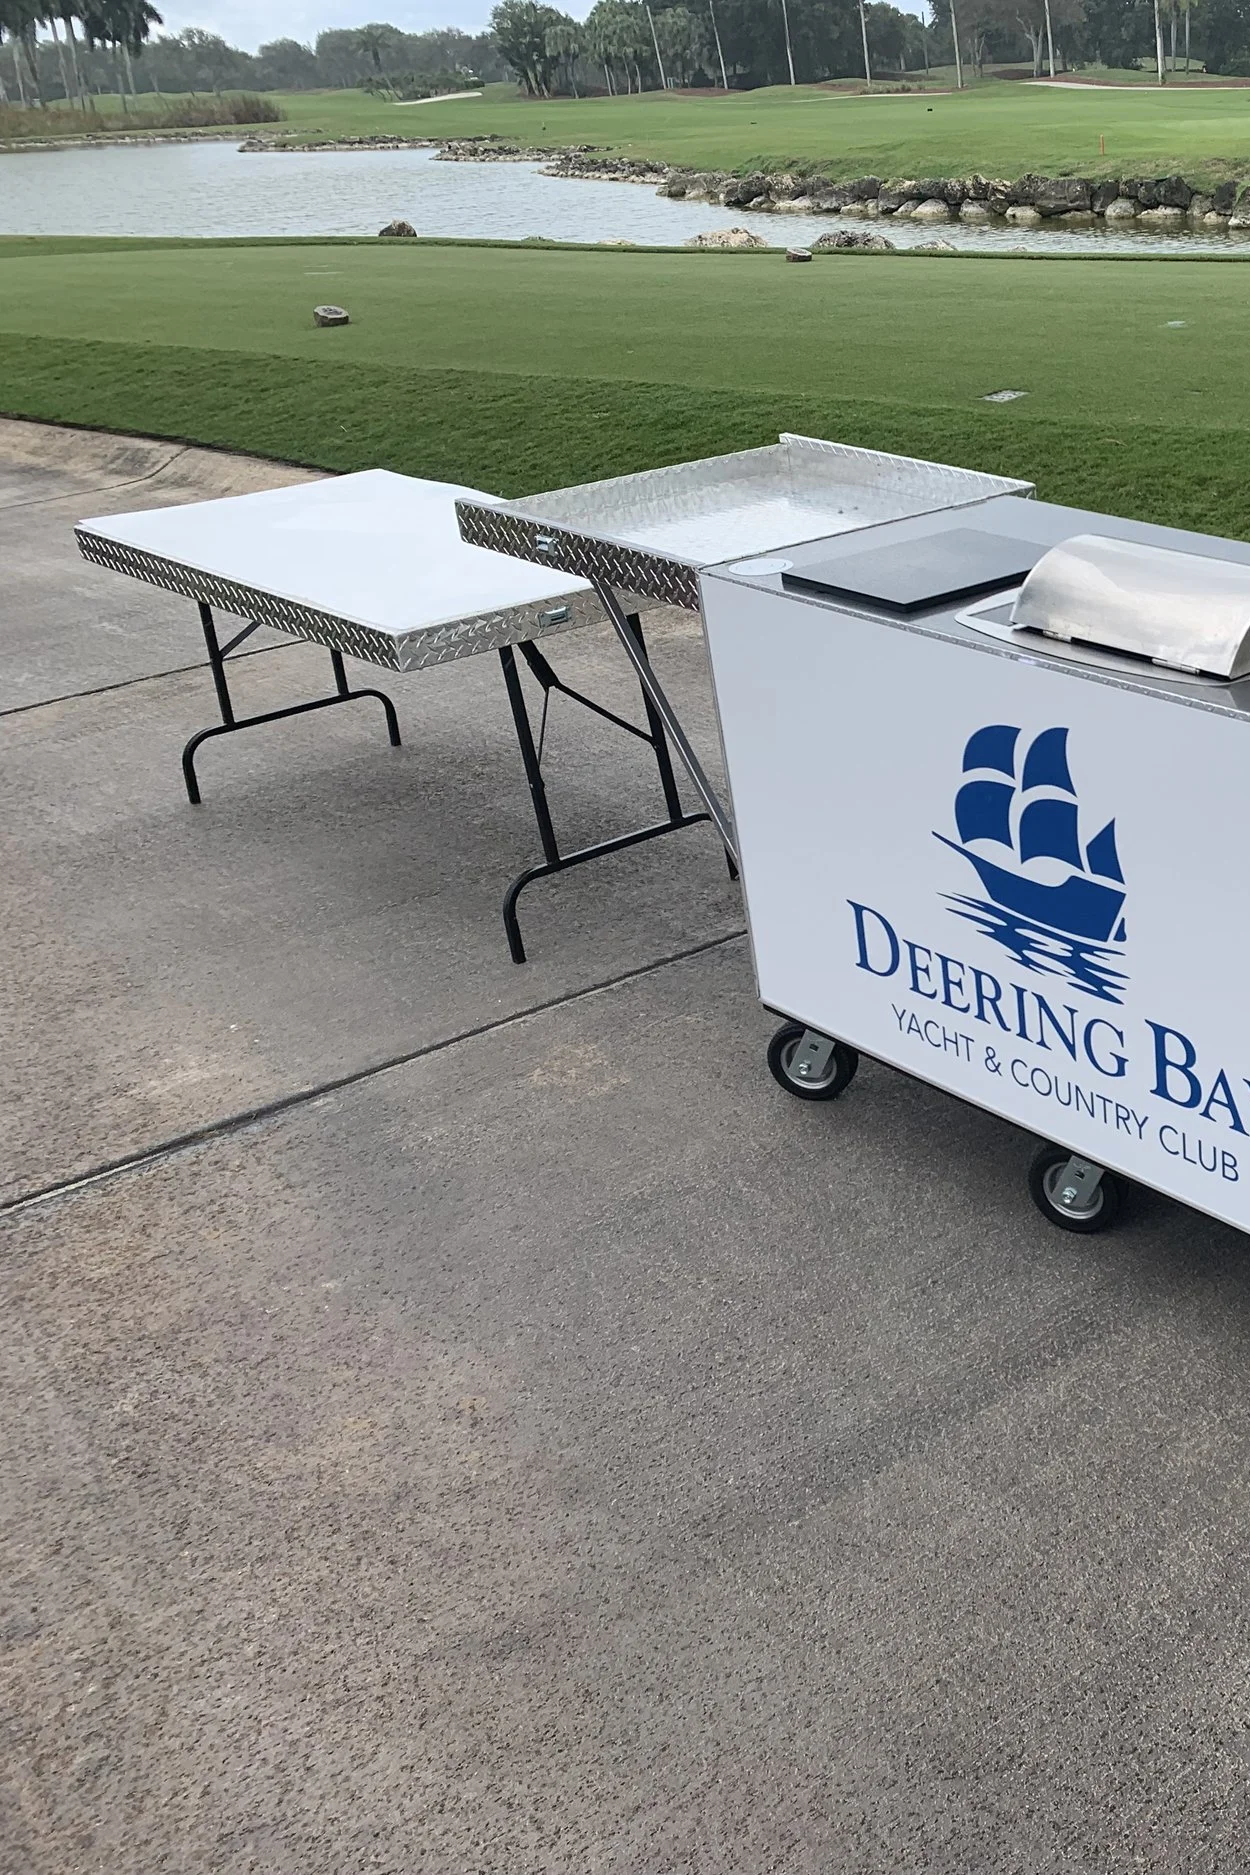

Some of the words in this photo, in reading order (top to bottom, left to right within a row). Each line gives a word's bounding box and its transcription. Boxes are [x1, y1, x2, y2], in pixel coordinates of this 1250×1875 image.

[845, 898, 1130, 1078] DEERING
[891, 1003, 975, 1062] YACHT
[984, 1045, 1003, 1077] &
[1010, 1058, 1149, 1140] COUNTRY
[1158, 1124, 1240, 1182] CLUB
